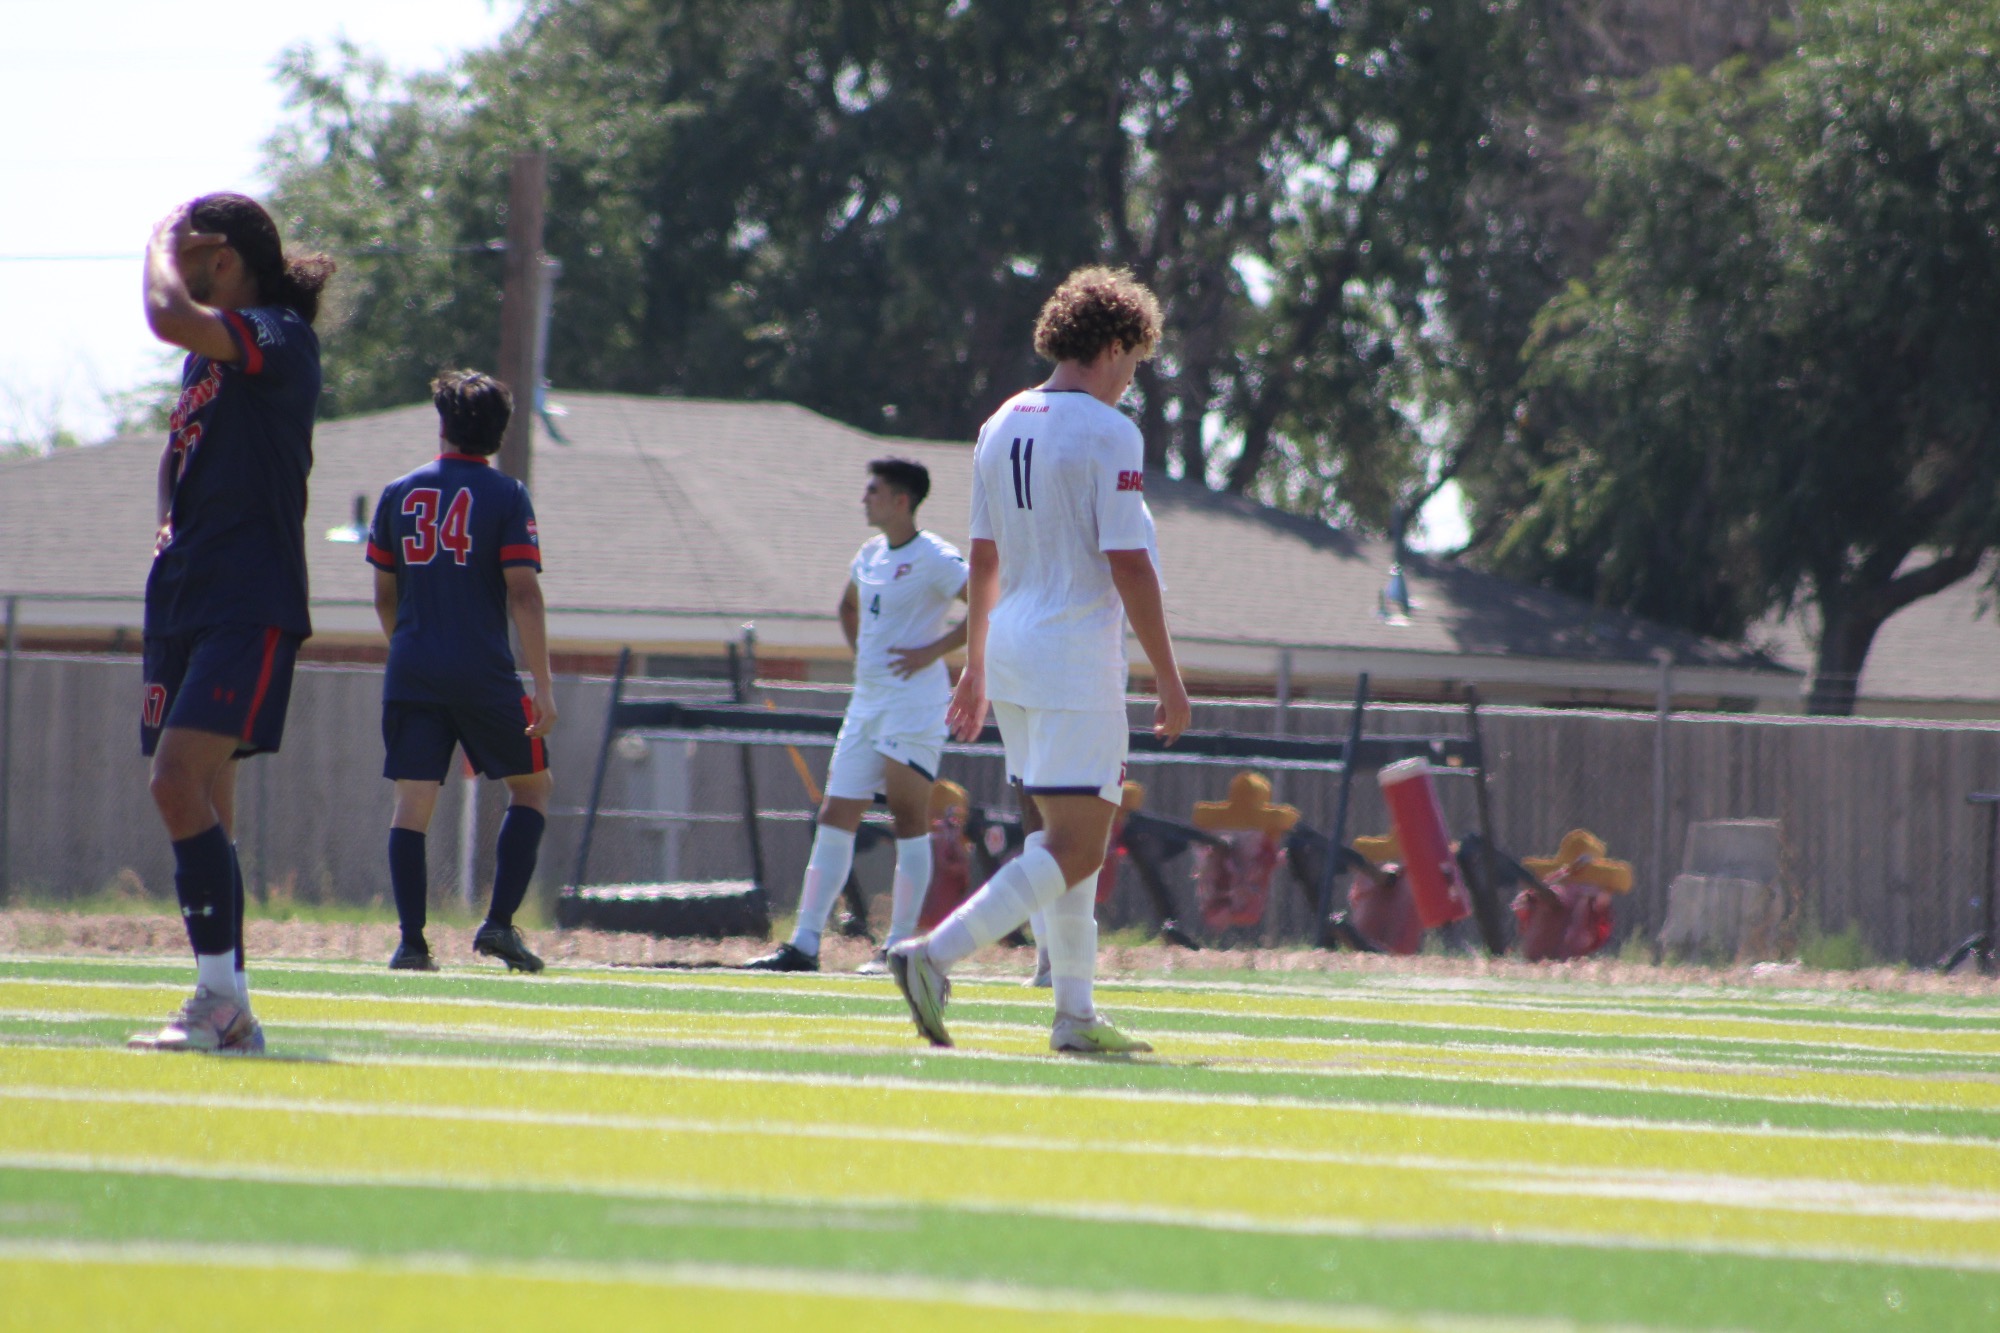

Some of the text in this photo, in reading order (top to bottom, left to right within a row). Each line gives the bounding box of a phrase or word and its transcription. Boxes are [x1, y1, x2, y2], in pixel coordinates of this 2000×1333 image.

[1010, 438, 1034, 510] 11
[401, 487, 473, 566] 34
[870, 594, 880, 620] 4
